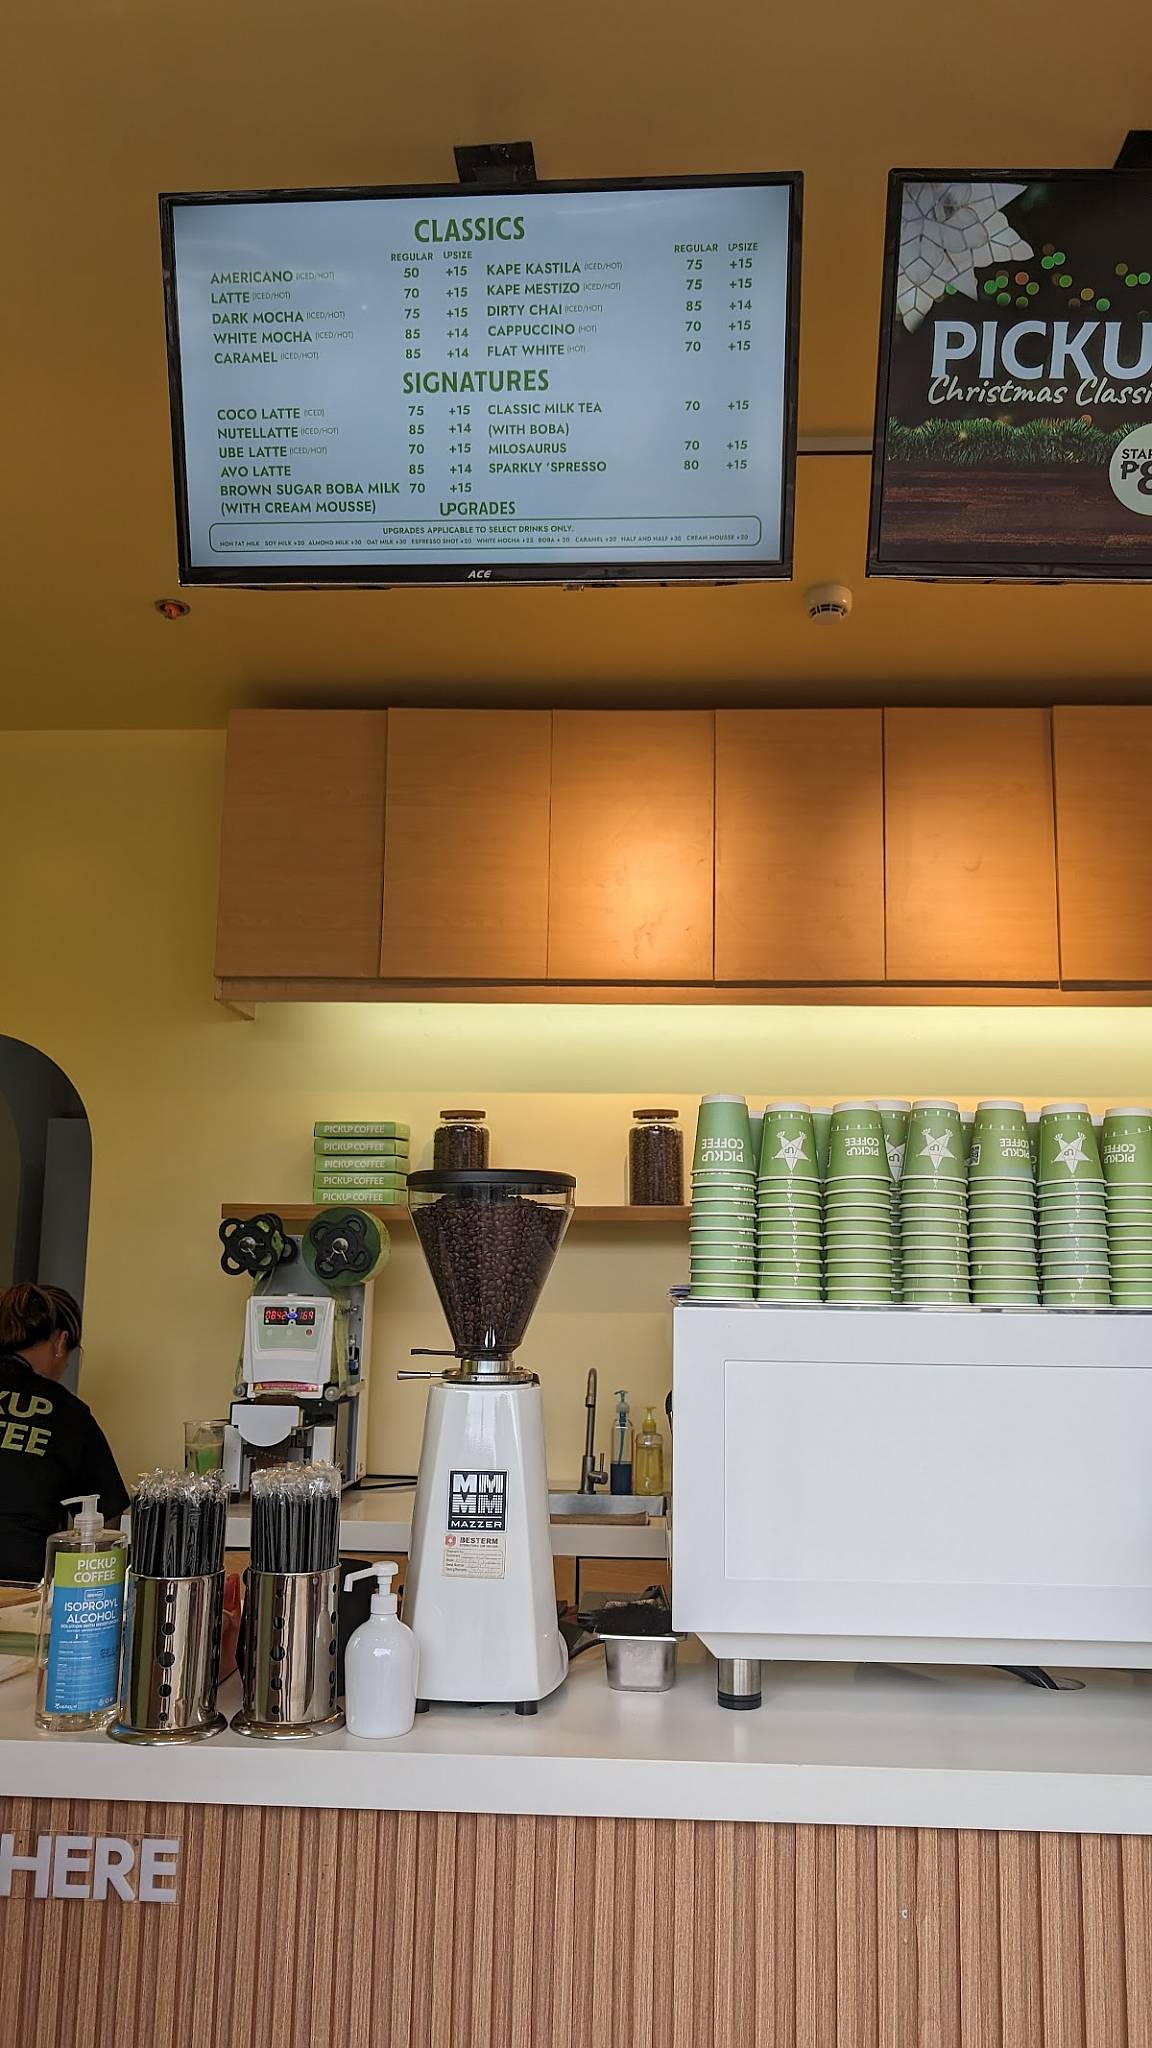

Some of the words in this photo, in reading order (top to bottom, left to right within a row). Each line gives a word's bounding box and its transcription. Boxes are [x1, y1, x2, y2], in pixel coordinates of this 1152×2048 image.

[414, 216, 525, 243] CLASSICS
[674, 243, 718, 253] REGULAR
[728, 242, 758, 252] UPSIZE
[391, 252, 433, 261] REGULAR
[443, 250, 472, 260] UPSIZE
[486, 263, 521, 275] KAPE
[525, 262, 581, 274] KASTILA
[687, 259, 703, 270] 75
[729, 258, 752, 269] +15
[210, 270, 293, 285] AMERICANO
[404, 267, 419, 278] 50
[446, 265, 467, 277] +15
[486, 284, 520, 296] KAPE
[525, 282, 580, 294] MESTIZO
[686, 279, 703, 290] 75
[729, 278, 752, 289] +15
[211, 292, 250, 304] LATTE
[404, 288, 419, 299] 70
[446, 286, 467, 298] +15
[212, 313, 248, 325] DARK
[253, 311, 304, 323] MOCHA
[405, 308, 420, 319] 75
[447, 307, 468, 318] +15
[487, 305, 525, 317] DIRTY
[529, 304, 562, 316] CHAI
[686, 301, 702, 311] 85
[729, 300, 752, 311] +14
[213, 332, 257, 345] WHITE
[261, 331, 312, 343] MOCHA
[405, 329, 420, 340] 85
[446, 327, 469, 339] +14
[488, 324, 575, 337] CAPPUCCINO
[685, 321, 701, 332] 70
[729, 320, 751, 331] +15
[214, 352, 277, 364] CARAMEL
[405, 348, 421, 359] 85
[447, 347, 469, 359] +14
[487, 345, 517, 357] FLAT
[522, 344, 565, 355] WHITE
[685, 341, 701, 352] 70
[728, 341, 750, 351] +15
[930, 320, 1152, 380] PICKU
[402, 369, 549, 394] SIGNATURES
[928, 374, 1068, 406] Christmas
[217, 409, 257, 421] COCO
[261, 408, 300, 420] LATTE
[408, 406, 424, 416] 75
[449, 405, 470, 416] +15
[488, 404, 541, 415] CLASSIC
[544, 403, 574, 414] MILK
[578, 402, 602, 413] TEA
[685, 401, 700, 411] 70
[727, 400, 749, 410] +15
[217, 427, 298, 440] NUTELLATTE
[408, 424, 424, 435] 85
[449, 423, 471, 434] +14
[488, 424, 525, 438] (WITH
[530, 423, 570, 437] BOBA)
[219, 447, 244, 459] UBE
[249, 446, 287, 457] LATTE
[408, 444, 424, 455] 70
[449, 443, 471, 454] +15
[488, 443, 567, 454] MILOSAURUS
[684, 441, 700, 451] 70
[726, 440, 748, 450] +15
[221, 467, 248, 477] AVO
[253, 465, 291, 477] LATTE
[409, 464, 424, 475] 85
[450, 463, 472, 474] +14
[489, 462, 542, 473] SPARKLY
[684, 460, 699, 470] 80
[726, 460, 747, 470] +15
[220, 484, 271, 496] BROWN
[276, 483, 322, 495] SUGAR
[326, 483, 363, 494] BOBA
[368, 482, 400, 493] MILK
[410, 483, 425, 494] 70
[450, 483, 472, 493] +15
[221, 502, 260, 516] (WITH
[265, 501, 311, 514] CREAM
[316, 500, 376, 514] MOUSSE)
[439, 501, 516, 517] UPGRADES
[467, 570, 492, 579] ACE
[324, 1125, 353, 1133] PICKUP
[354, 1125, 384, 1133] COFFEE
[324, 1143, 352, 1151] PICKUP
[354, 1143, 384, 1151] COFFEE
[702, 1138, 744, 1149] COFFEE
[845, 1137, 879, 1146] COFFEE
[702, 1150, 743, 1162] PICKUP
[847, 1147, 879, 1156] PICKUP
[325, 1160, 353, 1168] PICKUP
[355, 1160, 384, 1168] COFFEE
[78, 1557, 116, 1570] PICKUP
[74, 1570, 116, 1583] COFFEE
[65, 1598, 118, 1611] ISOPROPYL
[67, 1611, 115, 1623] ALCOHOL
[0, 1834, 180, 1902] HERE
